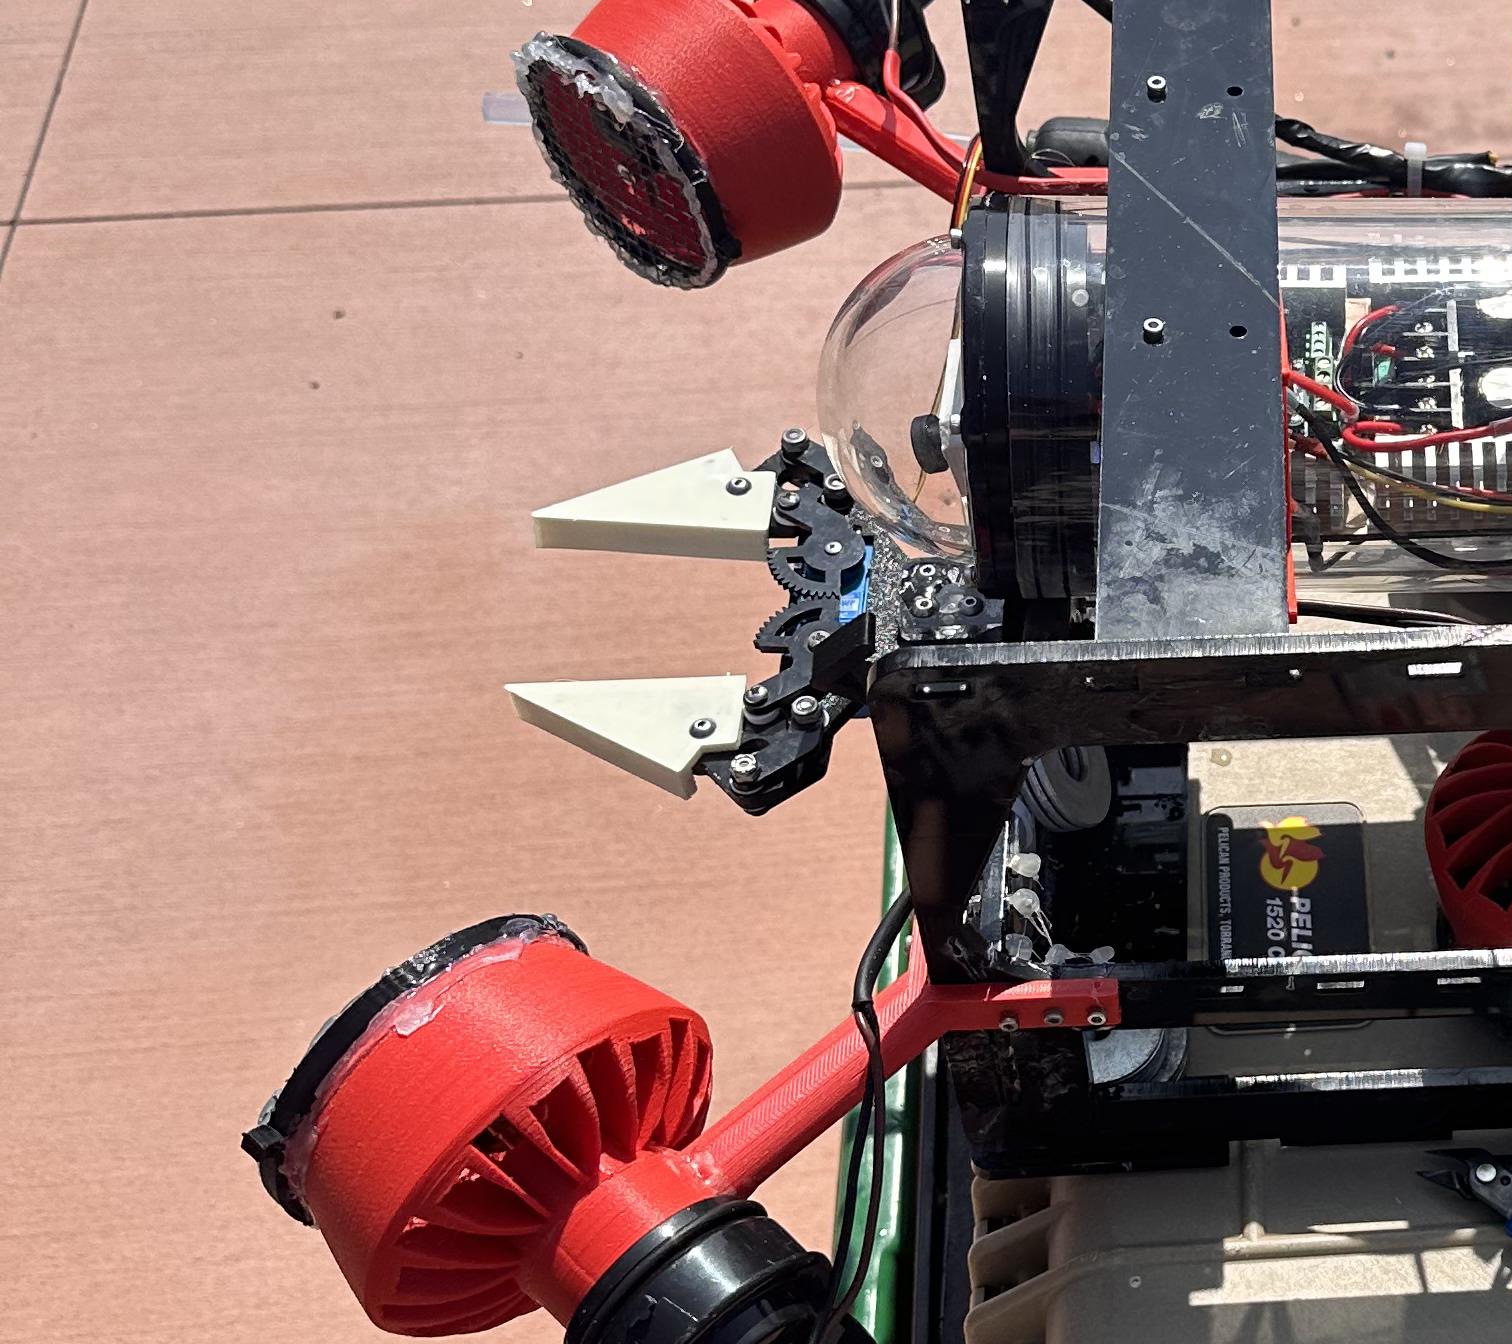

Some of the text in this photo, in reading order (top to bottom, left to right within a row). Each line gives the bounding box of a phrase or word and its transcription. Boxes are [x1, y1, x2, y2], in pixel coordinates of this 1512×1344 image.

[1218, 826, 1231, 865] PELICAN
[1219, 866, 1232, 916] PRODUCTS,
[1266, 897, 1285, 941] 1520
